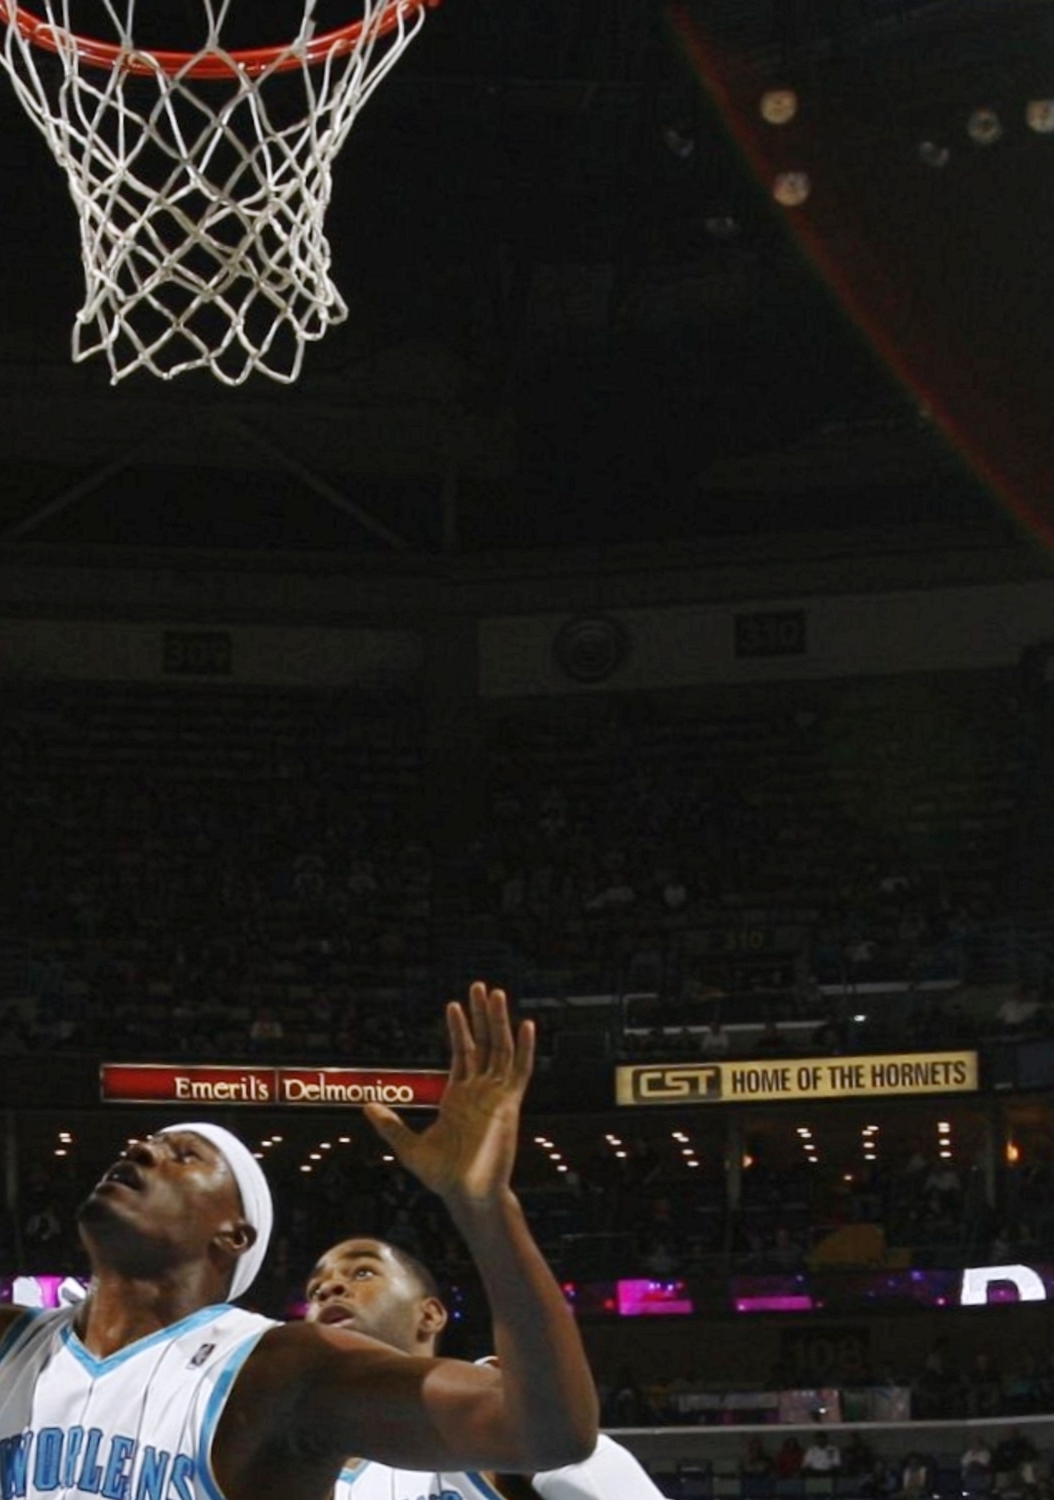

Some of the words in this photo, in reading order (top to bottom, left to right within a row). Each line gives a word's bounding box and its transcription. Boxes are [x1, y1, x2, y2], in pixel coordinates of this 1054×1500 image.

[174, 1074, 269, 1100] Emeril's
[283, 1072, 414, 1103] Delmonico
[638, 1069, 716, 1099] CST
[731, 1067, 792, 1094] HOME
[797, 1064, 824, 1091] OF
[827, 1062, 866, 1090] THE
[871, 1060, 967, 1088] HORNETS
